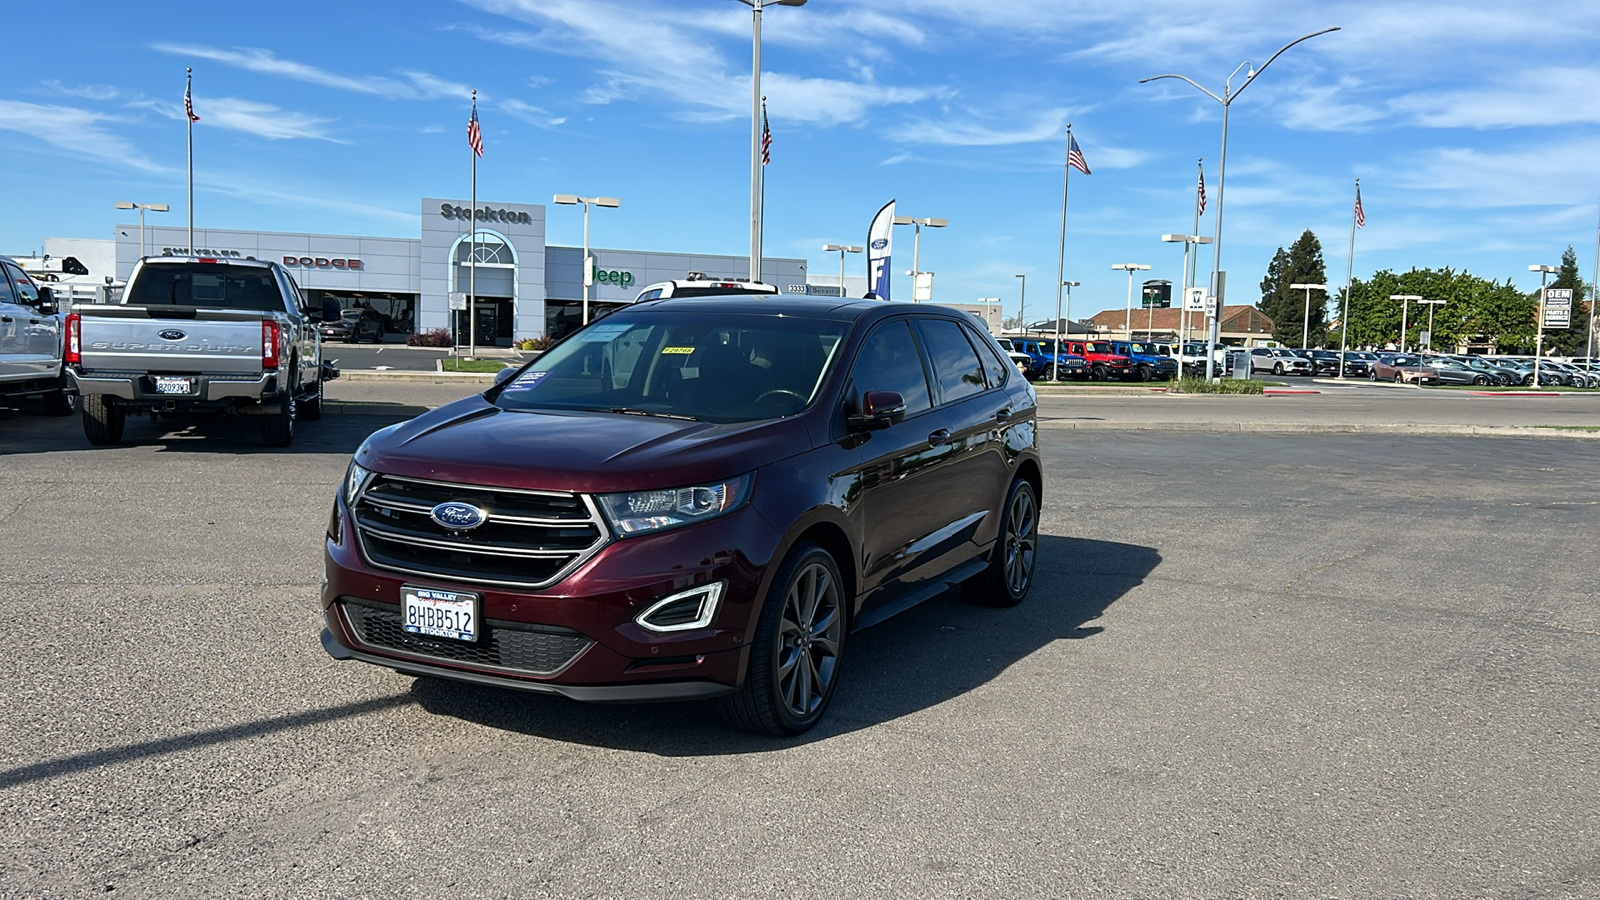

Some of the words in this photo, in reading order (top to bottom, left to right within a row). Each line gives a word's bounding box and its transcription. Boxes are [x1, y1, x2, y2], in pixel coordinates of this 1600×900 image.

[440, 203, 530, 224] Stockton
[283, 256, 361, 269] DODGE
[812, 287, 841, 295] Service
[1547, 290, 1570, 298] OEM
[92, 342, 179, 351] SUPER
[187, 343, 253, 353] DUTY
[442, 506, 472, 523] Ford
[431, 592, 457, 600] VALLEY
[408, 605, 471, 633] 8HBB512
[420, 626, 459, 639] STOCKTON
